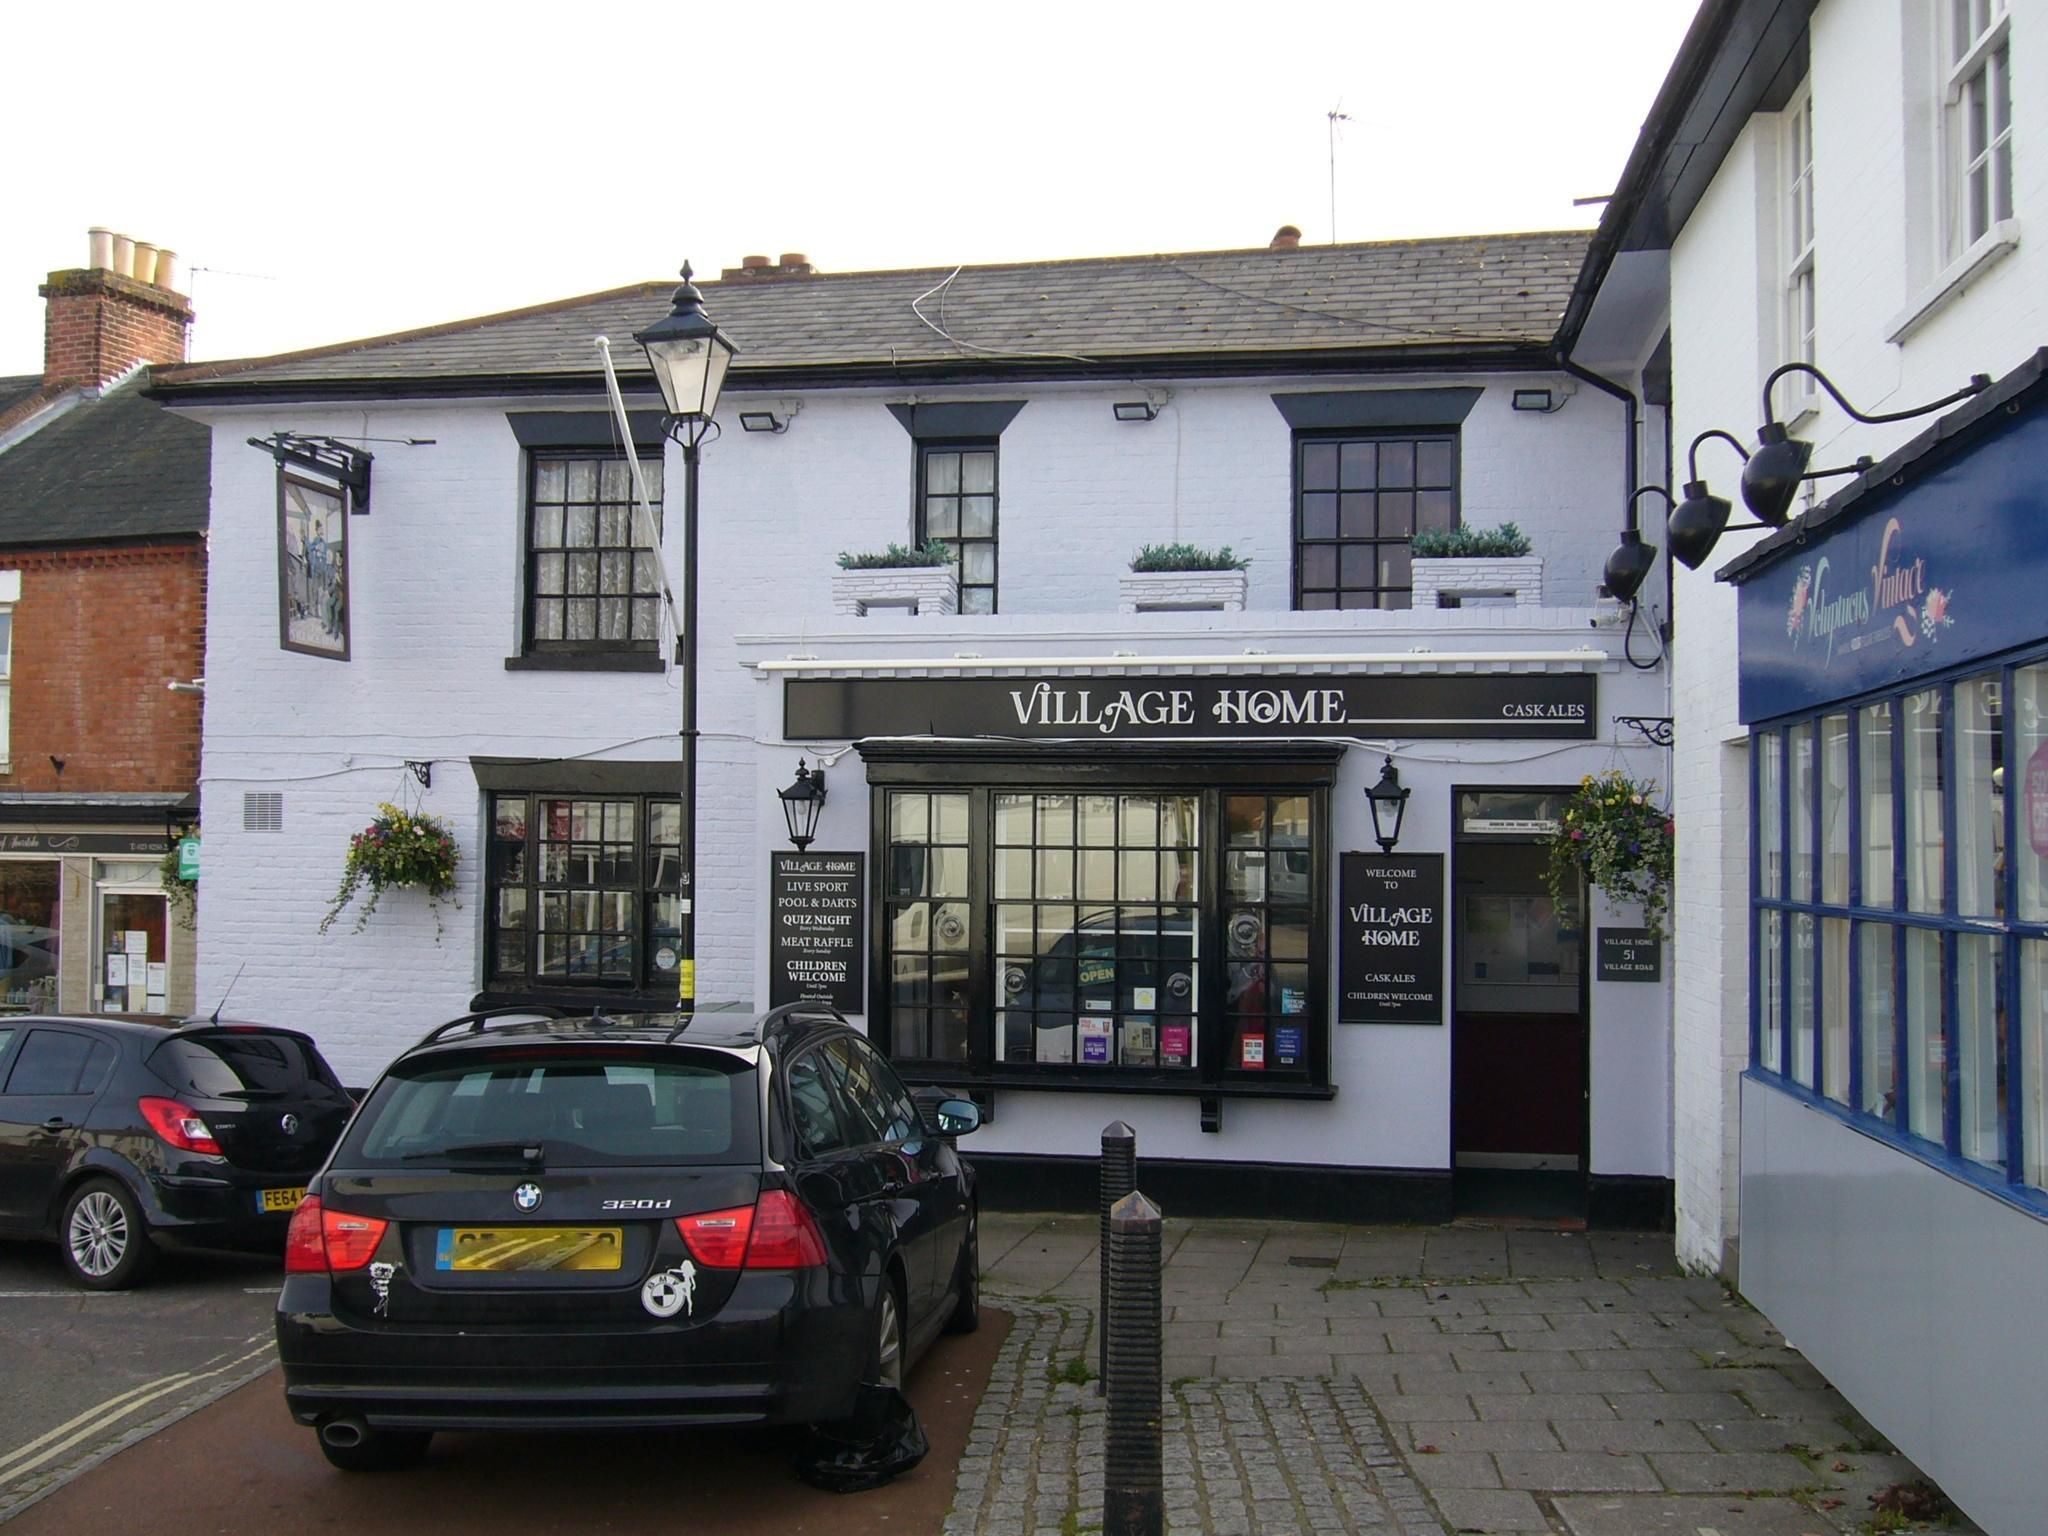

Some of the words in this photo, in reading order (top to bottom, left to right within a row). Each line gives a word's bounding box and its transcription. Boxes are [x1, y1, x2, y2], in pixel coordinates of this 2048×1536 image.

[1009, 682, 1195, 733] VILLAGE
[1212, 690, 1346, 723] HOME
[1502, 704, 1544, 717] CASK
[1547, 704, 1585, 717] ALES
[780, 860, 822, 872] VILLAGE
[825, 861, 856, 872] HOME
[1365, 869, 1416, 878] WELCOME
[787, 882, 811, 891] LIVE
[814, 882, 848, 892] SPORT
[1384, 881, 1398, 889] TO
[778, 898, 808, 907] POOL
[811, 898, 819, 907] &
[822, 898, 857, 908] DARTS
[783, 915, 812, 926] QUIZ
[814, 915, 852, 925] NIGHT
[1350, 903, 1432, 927] VILLAGE
[781, 937, 811, 947] MEAT
[813, 937, 853, 947] RAFFLE
[1361, 930, 1420, 946] HOME
[1604, 938, 1632, 946] VILLAGE
[1623, 949, 1635, 960] 51
[787, 960, 847, 971] CHILDREN
[788, 971, 846, 982] WELCOME
[1080, 968, 1115, 983] OPEN
[1365, 973, 1391, 983] CASK
[1392, 974, 1416, 983] ALES
[1347, 992, 1390, 1000] CHILDREN
[1391, 993, 1433, 1001] WELCOME
[264, 1190, 298, 1207] FE64
[602, 1200, 671, 1209] 320d
